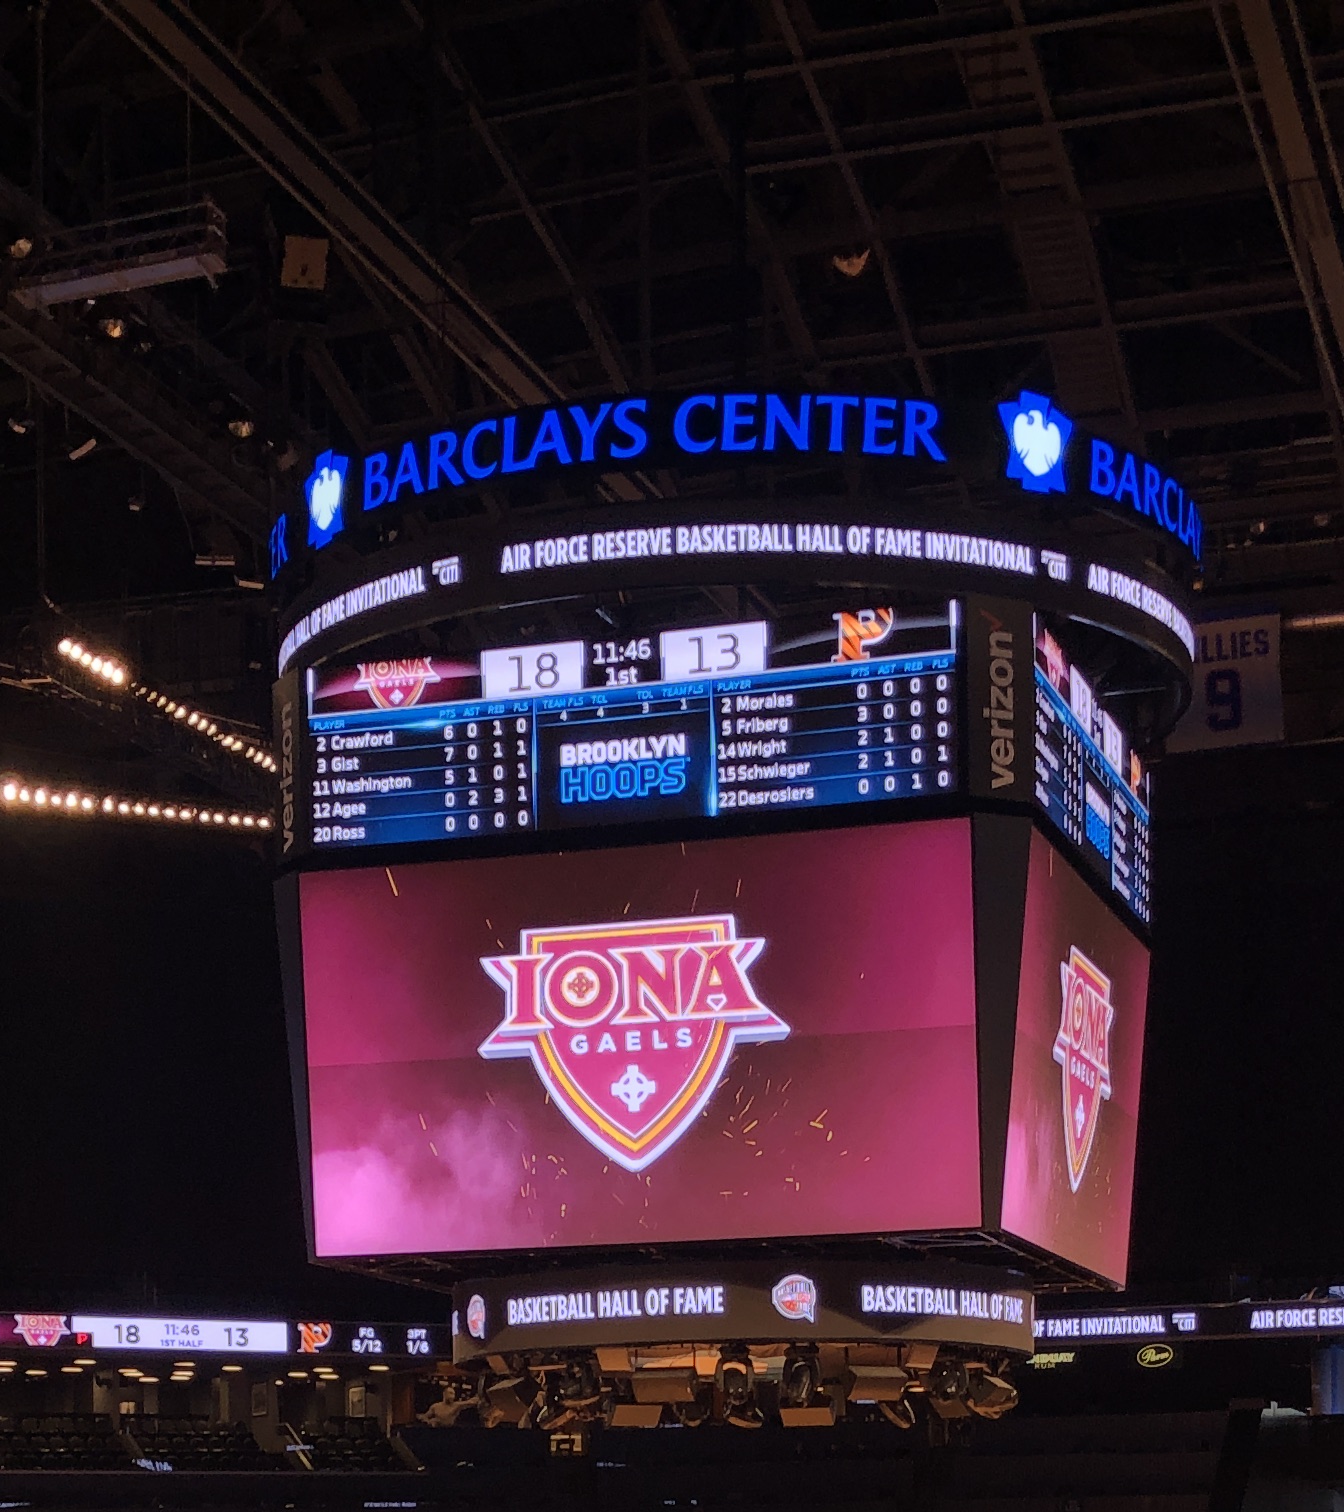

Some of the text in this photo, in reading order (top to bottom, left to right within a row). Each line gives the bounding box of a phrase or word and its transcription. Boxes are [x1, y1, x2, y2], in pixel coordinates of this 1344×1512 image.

[363, 394, 948, 511] BARCLAYS CENTER
[500, 544, 532, 574] AIR
[534, 534, 588, 569] FORCE
[592, 526, 672, 561] RESERVE
[675, 523, 793, 554] BASKETBALL
[796, 523, 843, 553] HALL
[846, 525, 871, 554] OF
[874, 527, 922, 558] FAME
[924, 531, 1036, 576] INVITATIONAL
[345, 565, 426, 617] INVITATIONAL
[1087, 562, 1110, 592] AIR
[1110, 571, 1142, 609] FORCE
[830, 605, 894, 663] P
[592, 639, 652, 665] 11:46
[687, 632, 741, 675] 13
[356, 656, 434, 685] IONA
[508, 651, 560, 694] 18
[605, 665, 639, 687] 1st
[721, 692, 794, 714] 2 Morales
[983, 630, 1015, 790] verizon
[1204, 668, 1244, 733] 9
[721, 717, 789, 736] 5 Friberg
[316, 730, 394, 752] 2 Crawford
[559, 731, 687, 768] BROOKLYN
[718, 738, 788, 760] 14 Wright
[279, 702, 295, 853] verizon
[316, 756, 360, 773] 3 Gist
[718, 761, 811, 783] 15 Schwieger
[313, 775, 413, 797] 11 Washington
[560, 757, 687, 804] HOOPS
[313, 801, 367, 819] 12 Agee
[718, 791, 737, 809] 22
[313, 825, 366, 843] 20 Ross
[505, 940, 767, 1033] IONA
[1058, 966, 1110, 1078] IONA
[569, 1027, 694, 1055] GAELS
[1069, 1054, 1096, 1091] GAELS
[507, 1285, 724, 1326] BASKETBALL HALL OF FAME
[861, 1284, 1024, 1325] BASKETBALL HALL OF FAME
[163, 1323, 200, 1337] 11:46
[1250, 1309, 1274, 1330] AIR
[1274, 1308, 1317, 1328] FORCE
[113, 1323, 141, 1344] 18
[223, 1326, 249, 1348] 13
[351, 1338, 383, 1354] 5/12
